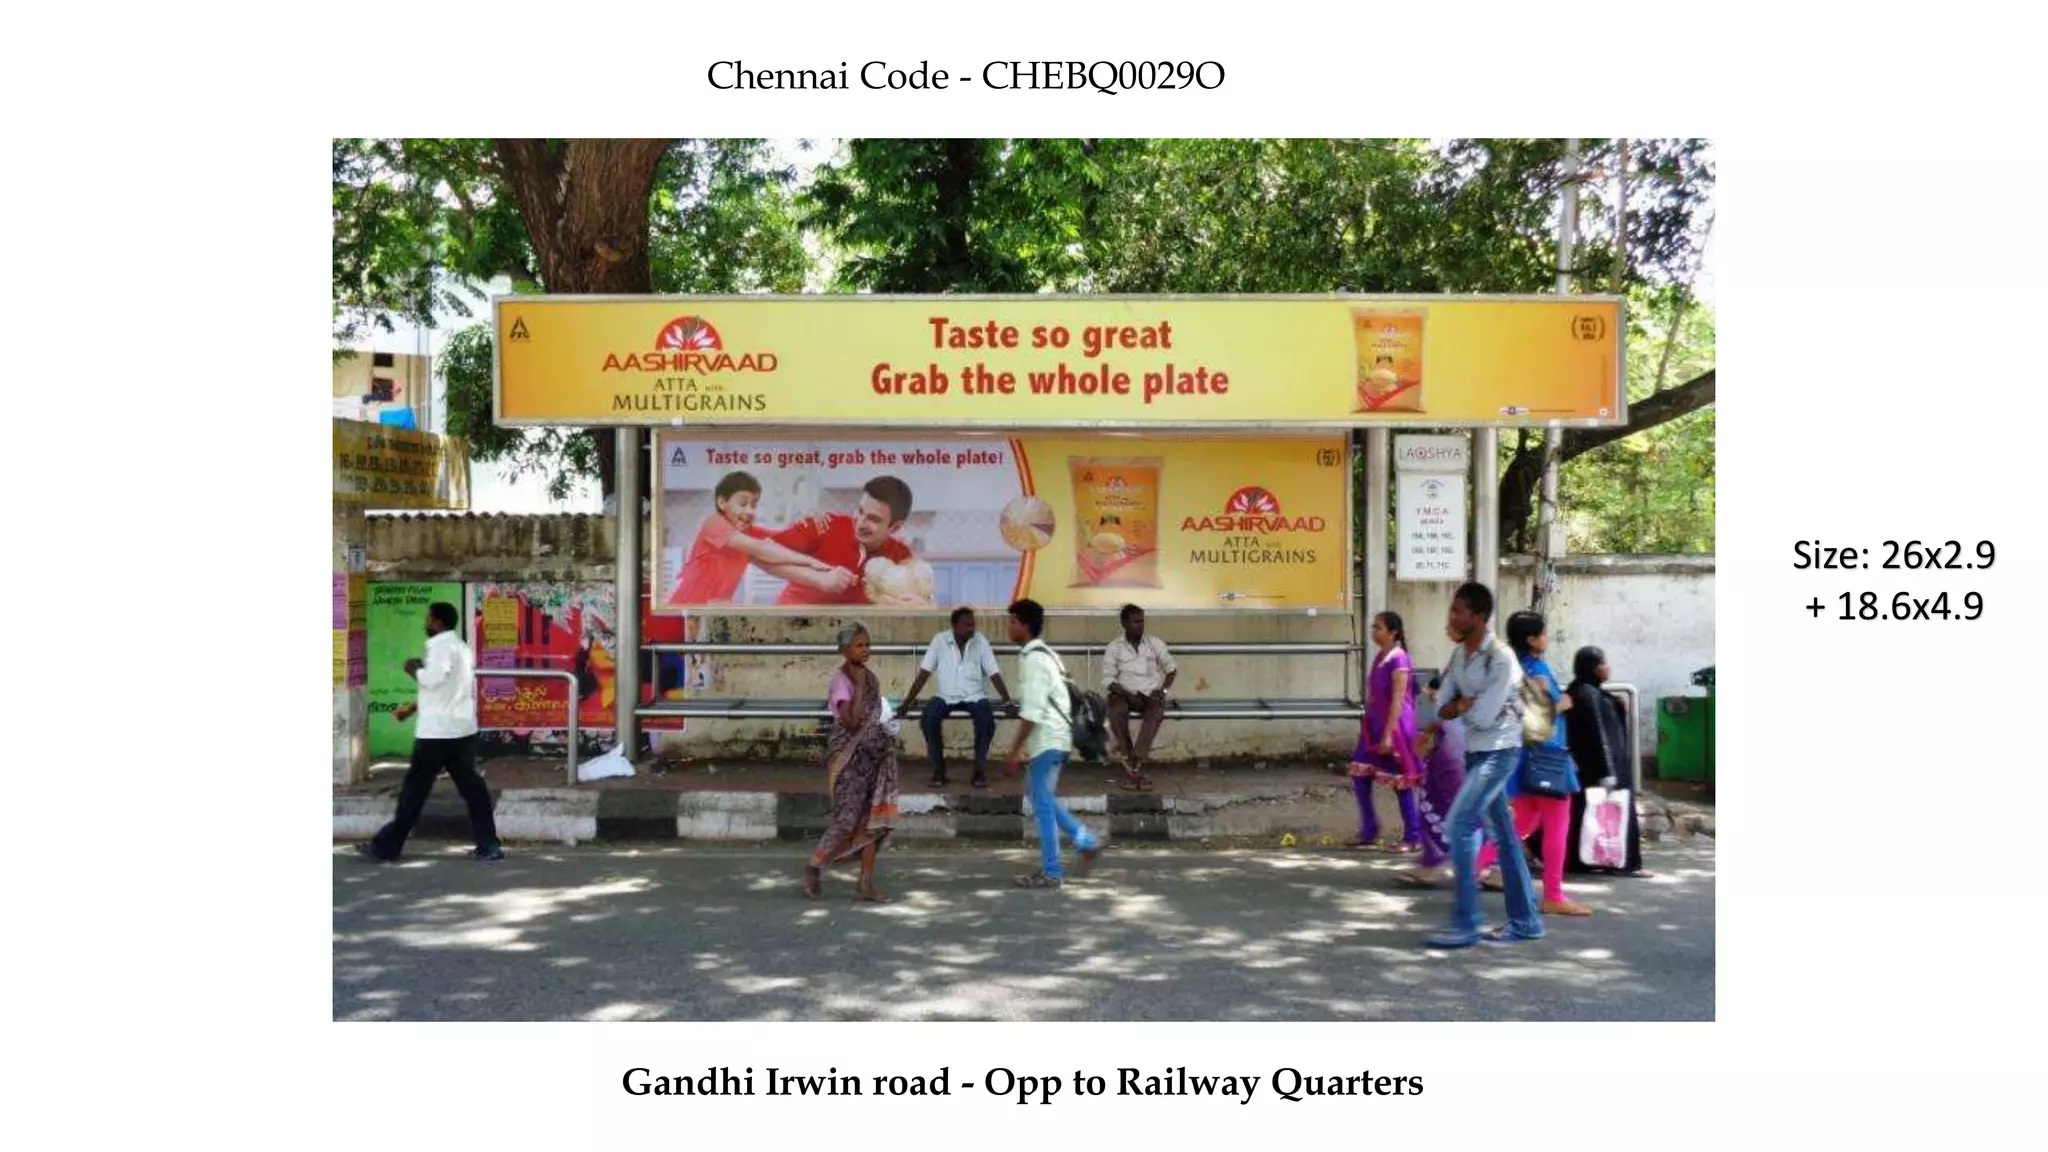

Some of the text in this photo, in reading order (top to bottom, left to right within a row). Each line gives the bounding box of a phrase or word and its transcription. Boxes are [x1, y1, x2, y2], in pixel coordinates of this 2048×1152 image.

[929, 317, 1173, 358] Taste so great
[602, 352, 778, 376] AASHIRVAAD
[653, 377, 698, 391] ATTA
[872, 362, 1229, 404] Grab the whole plate
[612, 394, 767, 411] MULTIGRAINS
[705, 448, 749, 465] Taste
[754, 451, 773, 465] so
[828, 448, 865, 468] grab
[870, 448, 897, 465] the
[902, 448, 951, 465] whole
[956, 448, 1003, 468] plate!
[1180, 516, 1326, 535] AASHIRVAAD
[1223, 536, 1260, 548] ATTA
[1190, 550, 1317, 563] MULTIGRAINS
